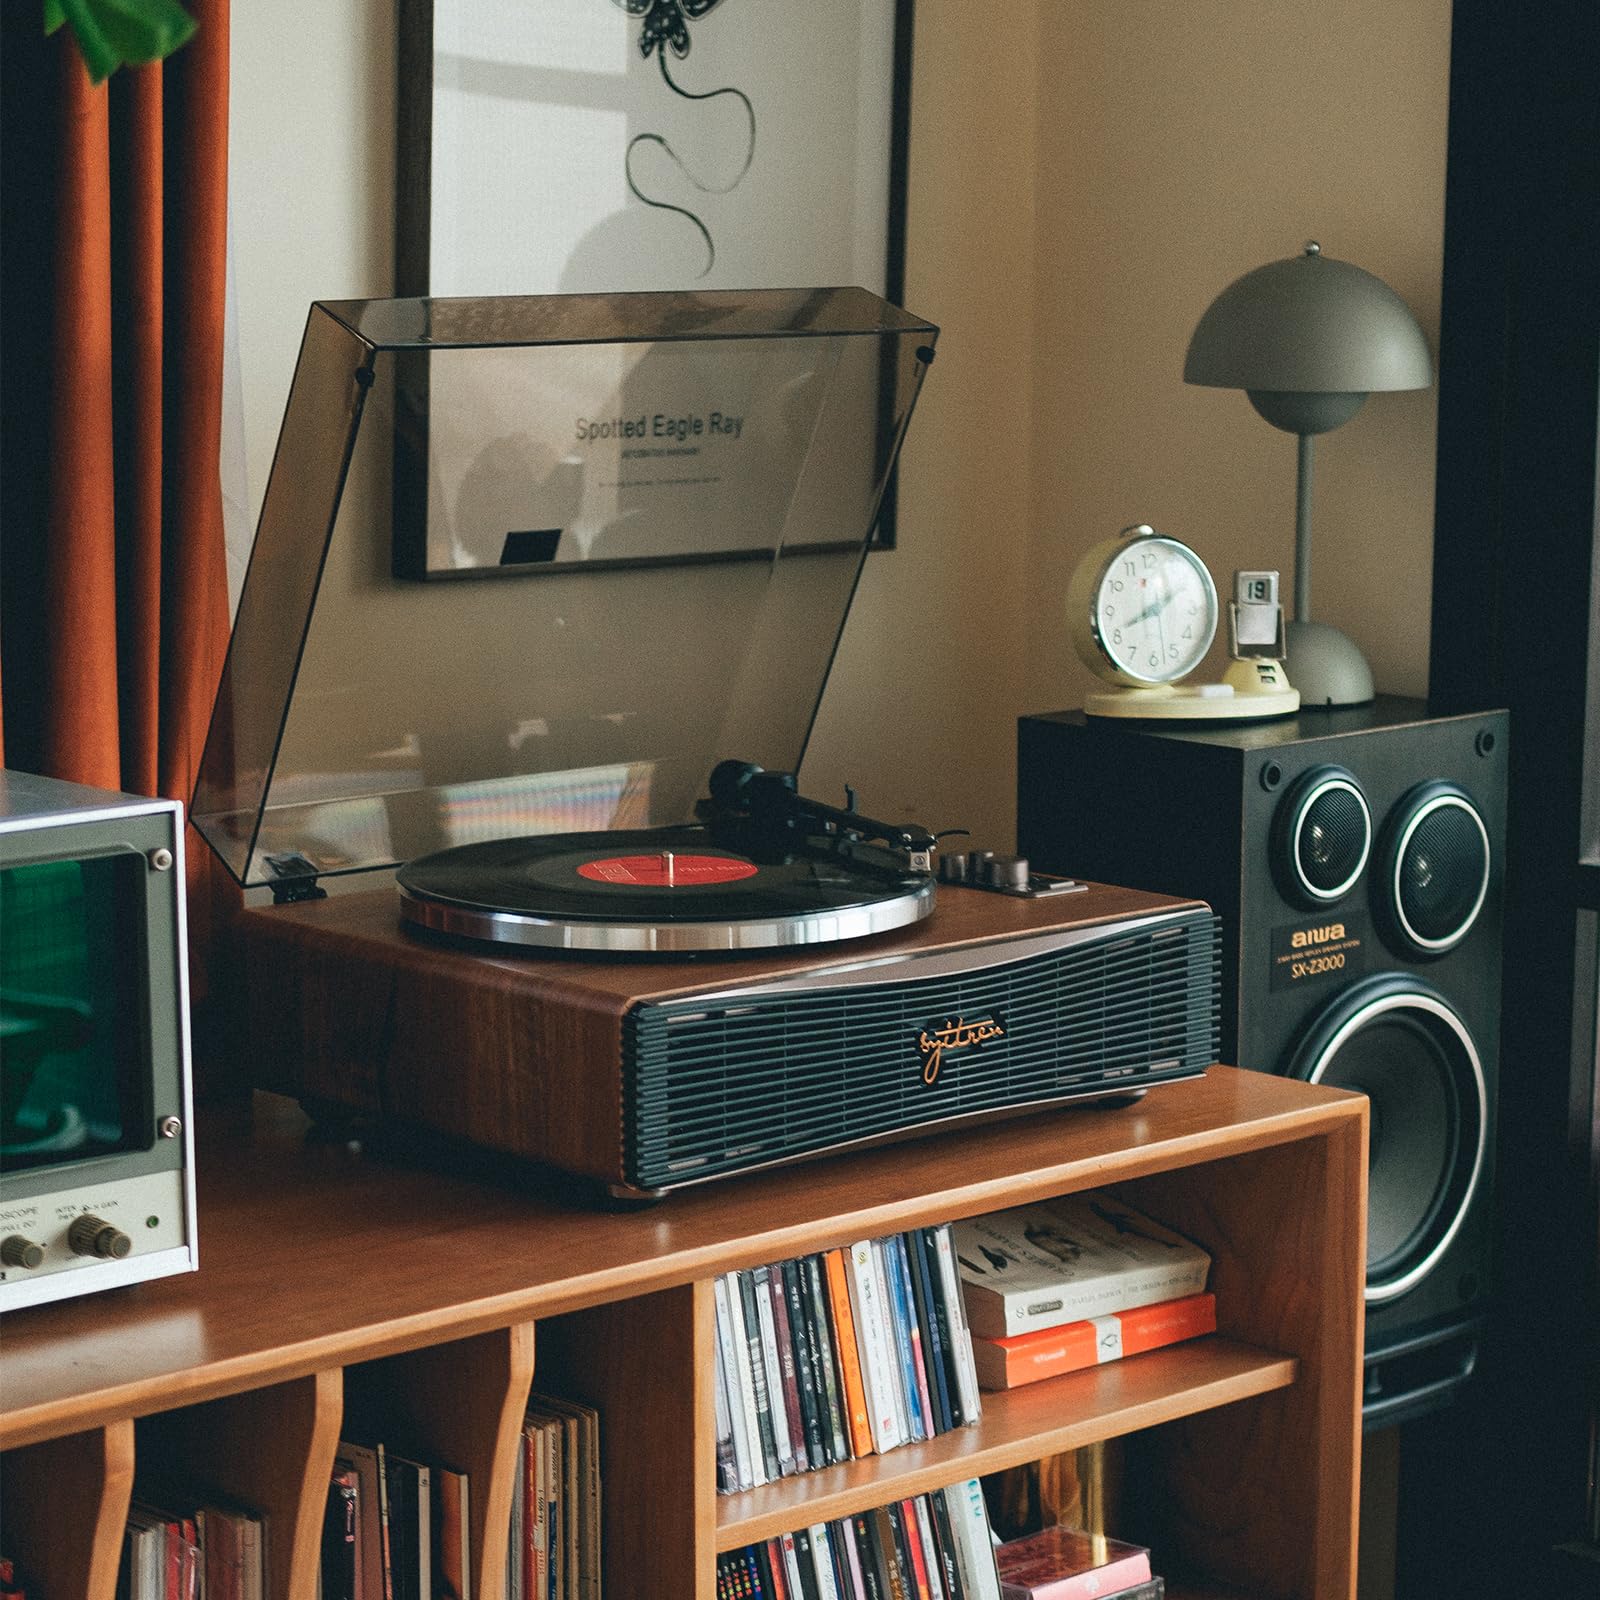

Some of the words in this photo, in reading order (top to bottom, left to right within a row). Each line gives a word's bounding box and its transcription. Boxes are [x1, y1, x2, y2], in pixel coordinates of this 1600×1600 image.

[576, 416, 646, 444] Spotted
[653, 415, 703, 441] Eagle
[709, 412, 745, 439] Ray
[1124, 561, 1136, 576] 11
[1142, 553, 1157, 570] 12
[1108, 579, 1124, 595] 10
[1247, 581, 1265, 600] 19
[1112, 629, 1122, 645] 8
[1181, 625, 1193, 640] 4
[1127, 646, 1137, 661] 7
[1169, 644, 1179, 659] 5
[1149, 653, 1159, 668] 6
[1291, 923, 1346, 948] aiwa
